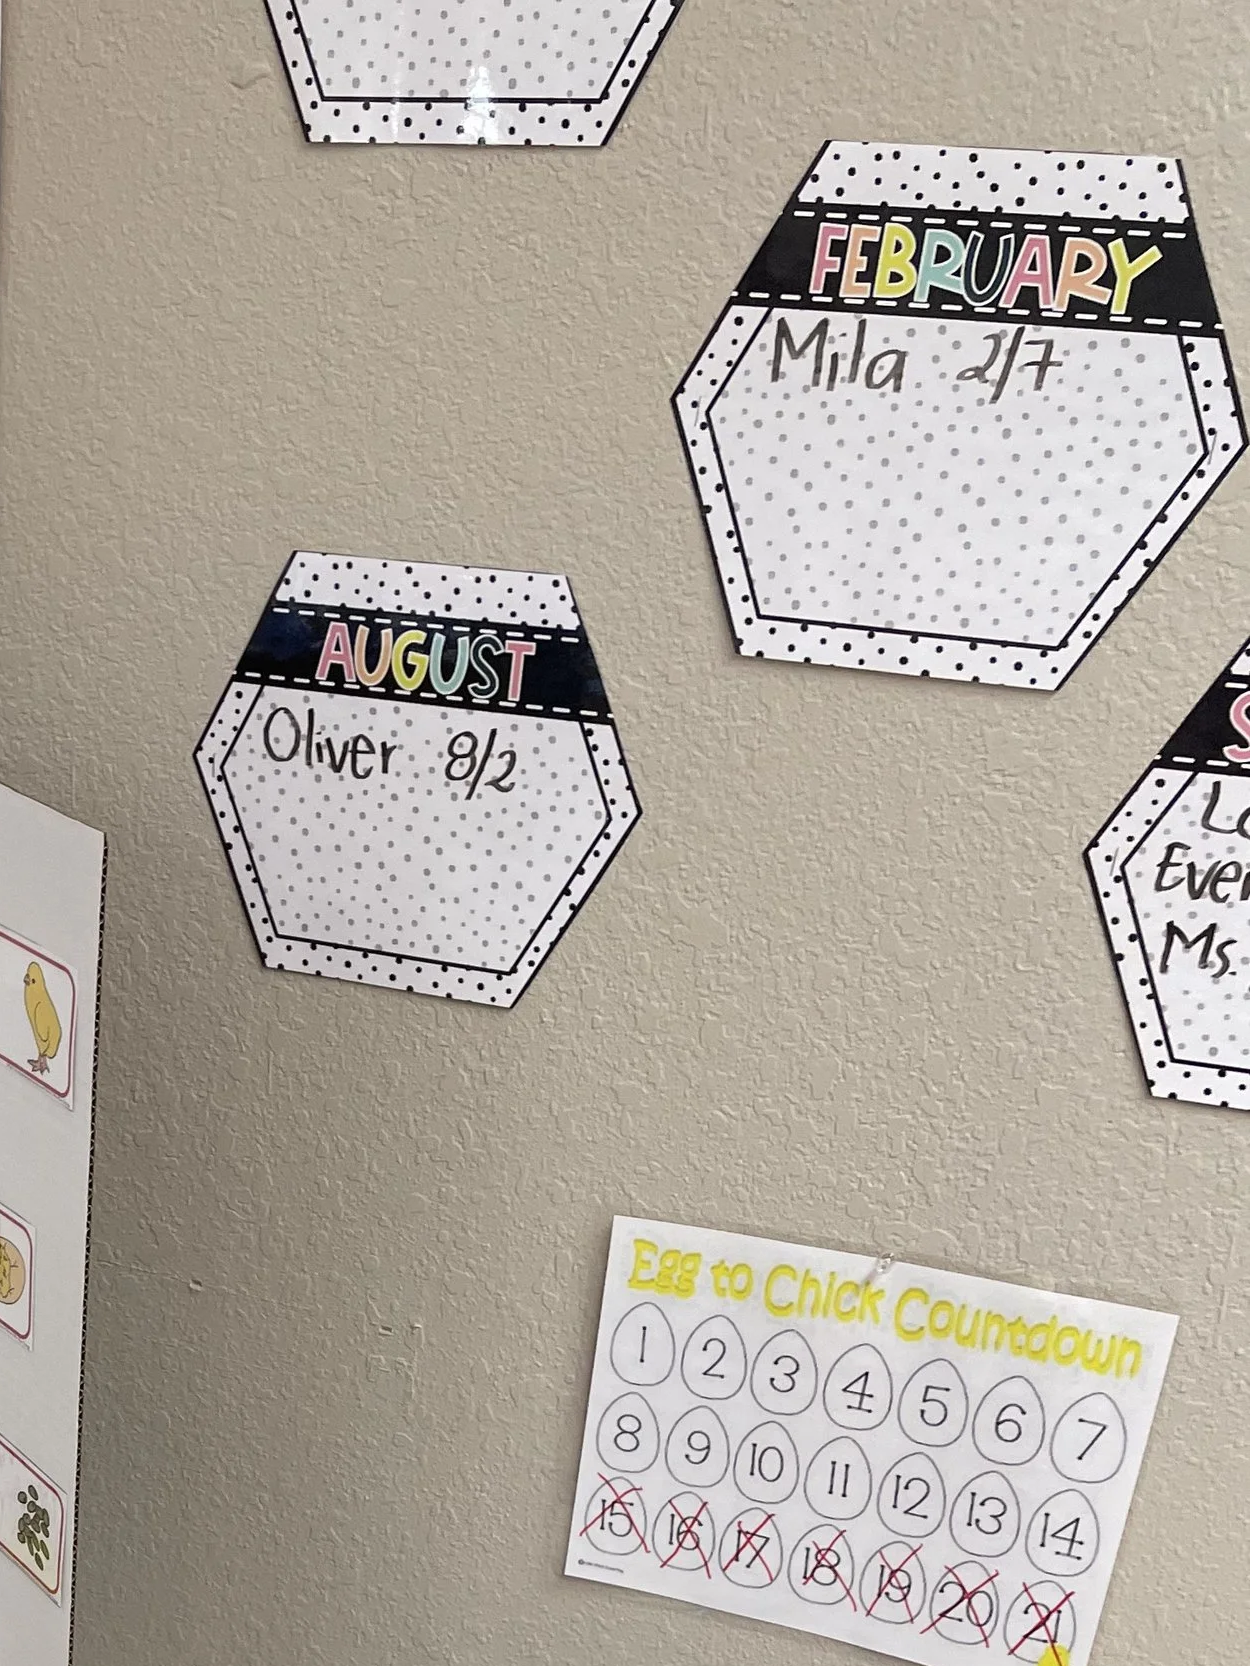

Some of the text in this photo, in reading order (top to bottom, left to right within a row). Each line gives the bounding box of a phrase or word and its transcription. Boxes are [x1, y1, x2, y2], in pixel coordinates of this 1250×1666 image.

[810, 222, 1163, 314] FEBRUARY
[771, 316, 1063, 404] Mila 2/7
[315, 621, 536, 701] AUGUST
[263, 706, 518, 800] Oliver 8/2
[1160, 921, 1237, 978] Ms.
[629, 1239, 1142, 1379] Egg to Chick Countdown
[702, 1338, 726, 1379] 2
[770, 1355, 799, 1392] 3
[842, 1371, 874, 1413] 4
[919, 1385, 950, 1426] 5
[995, 1404, 1026, 1442] 6
[1077, 1418, 1107, 1460] 7
[614, 1414, 1084, 1560] 8 9 10 11 12 13 14
[600, 1499, 1062, 1643] 15 16 17 18 19 20 21
